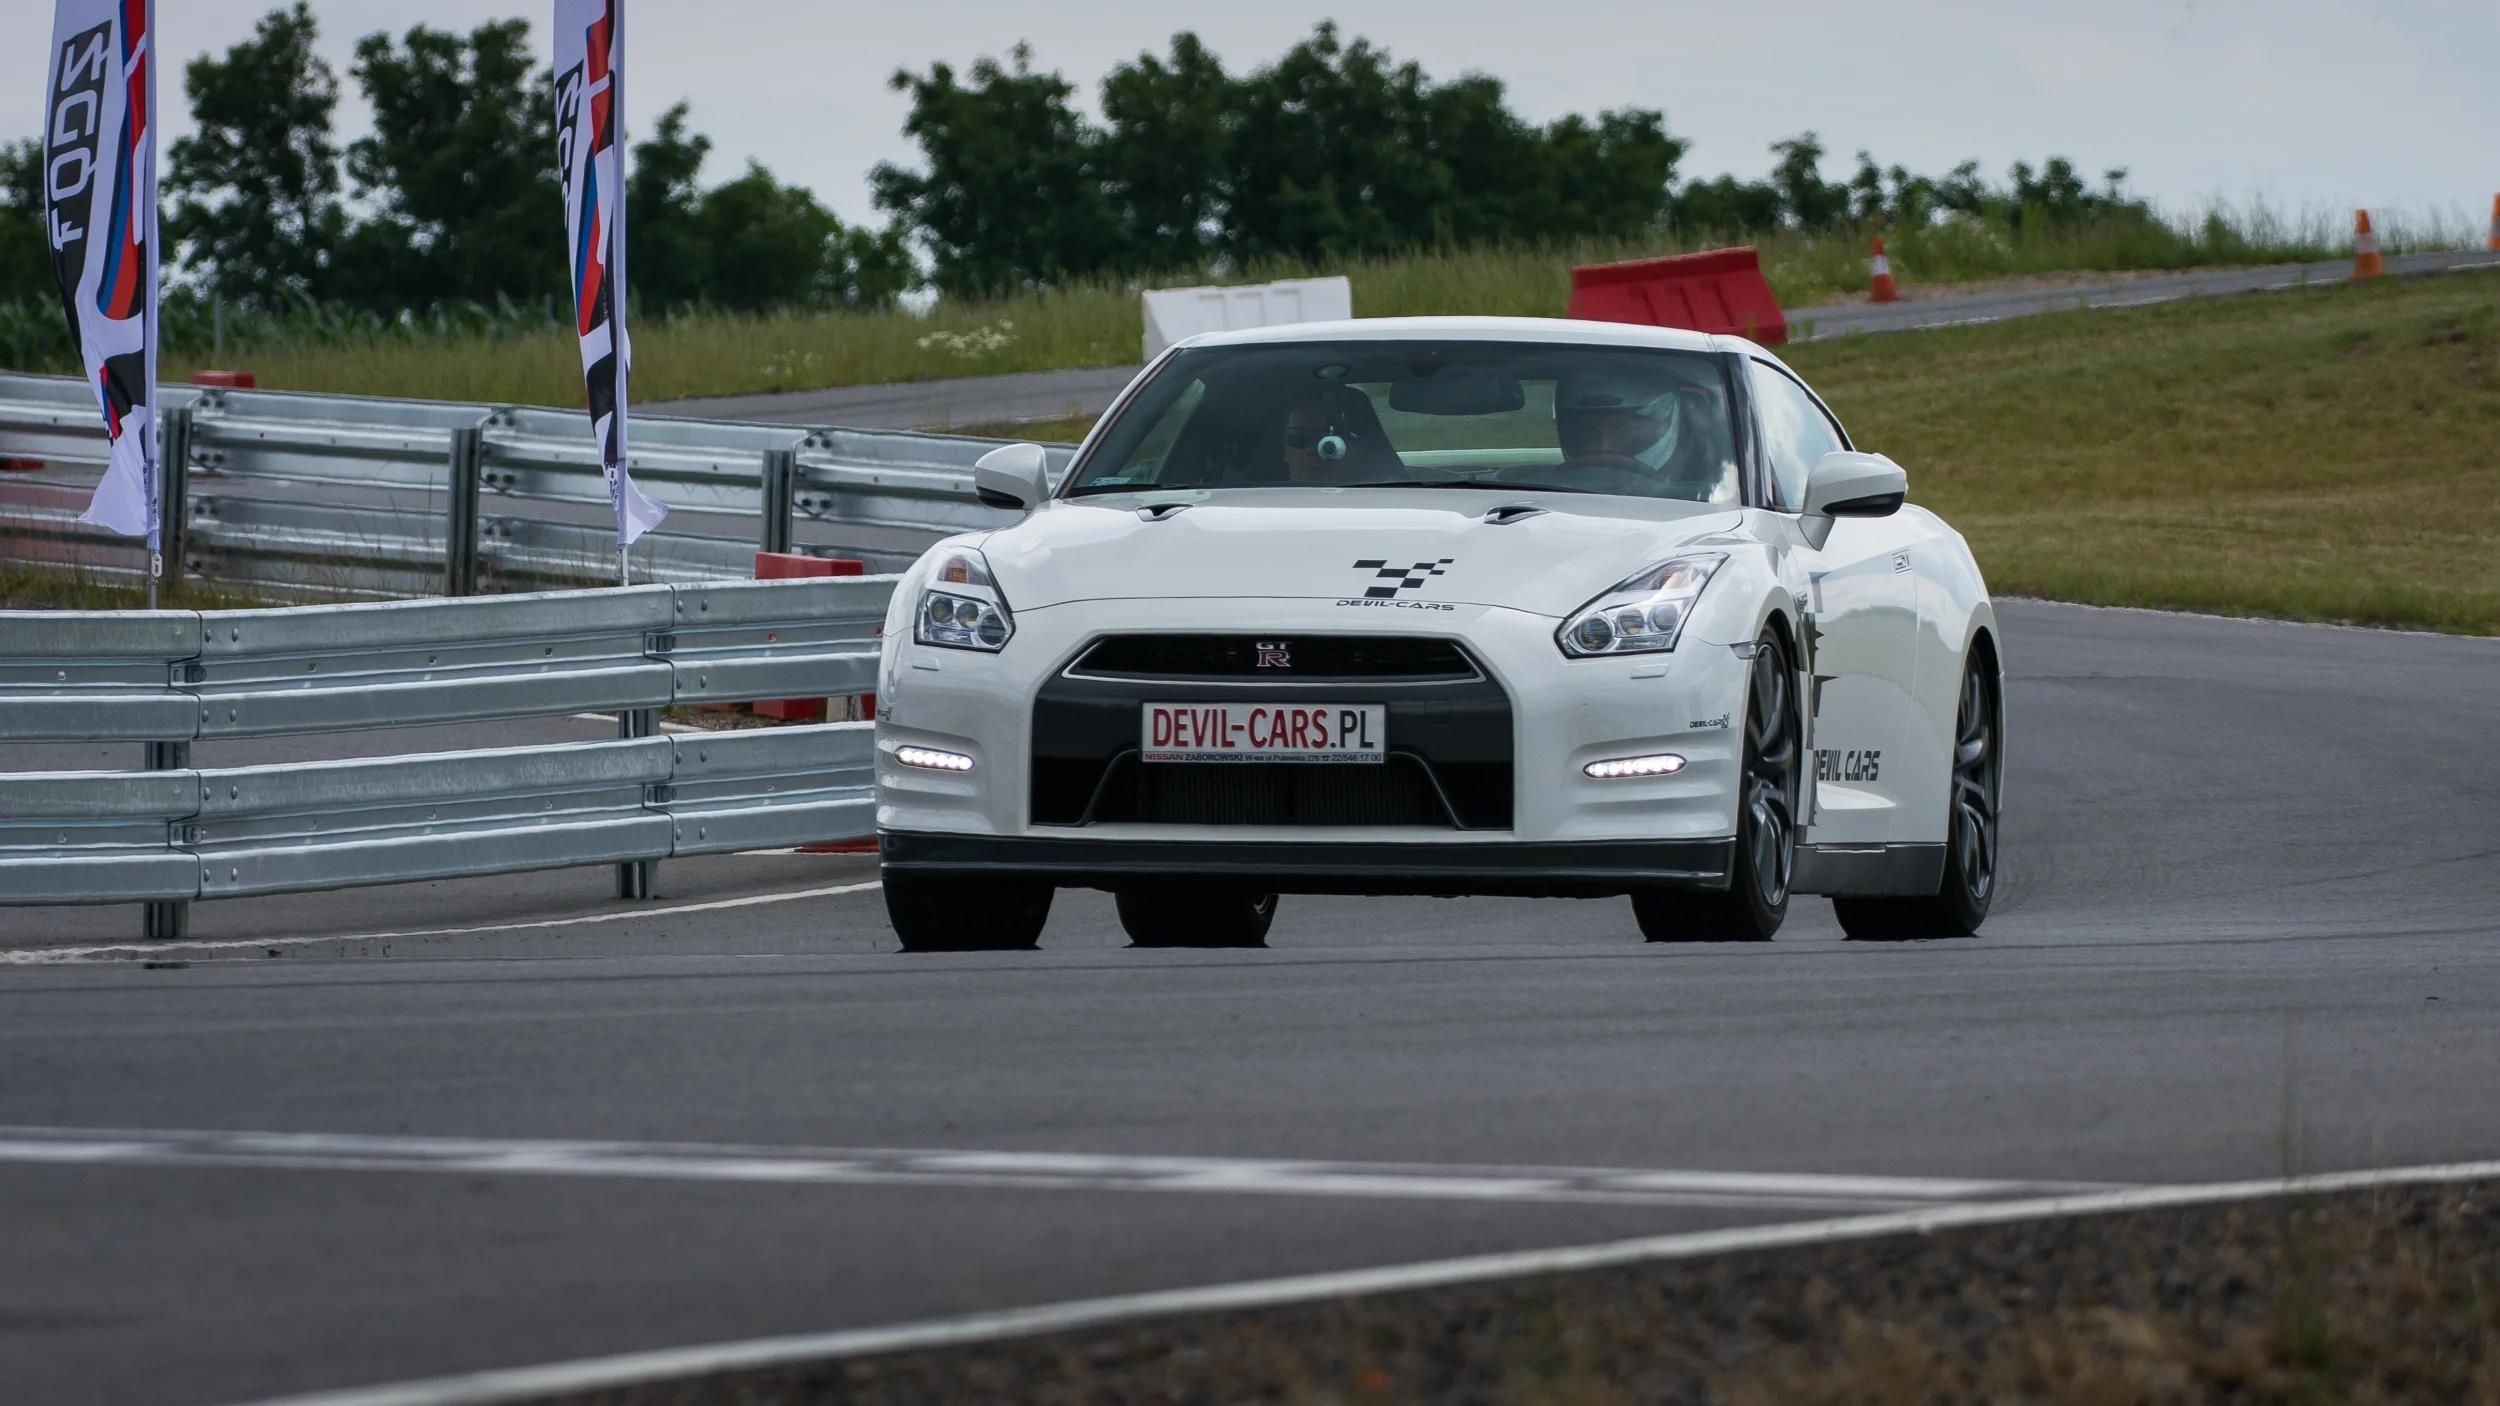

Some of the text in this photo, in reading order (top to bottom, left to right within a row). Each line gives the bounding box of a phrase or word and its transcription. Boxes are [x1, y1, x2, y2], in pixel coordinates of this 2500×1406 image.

[1336, 599, 1455, 612] DEVIL-CARS
[1152, 707, 1375, 749] DEVIL-CARS.PL
[1144, 753, 1184, 761] NISSAN
[1185, 752, 1243, 761] ZABOROWSKI
[1815, 749, 1881, 781] DEVIL CARS
